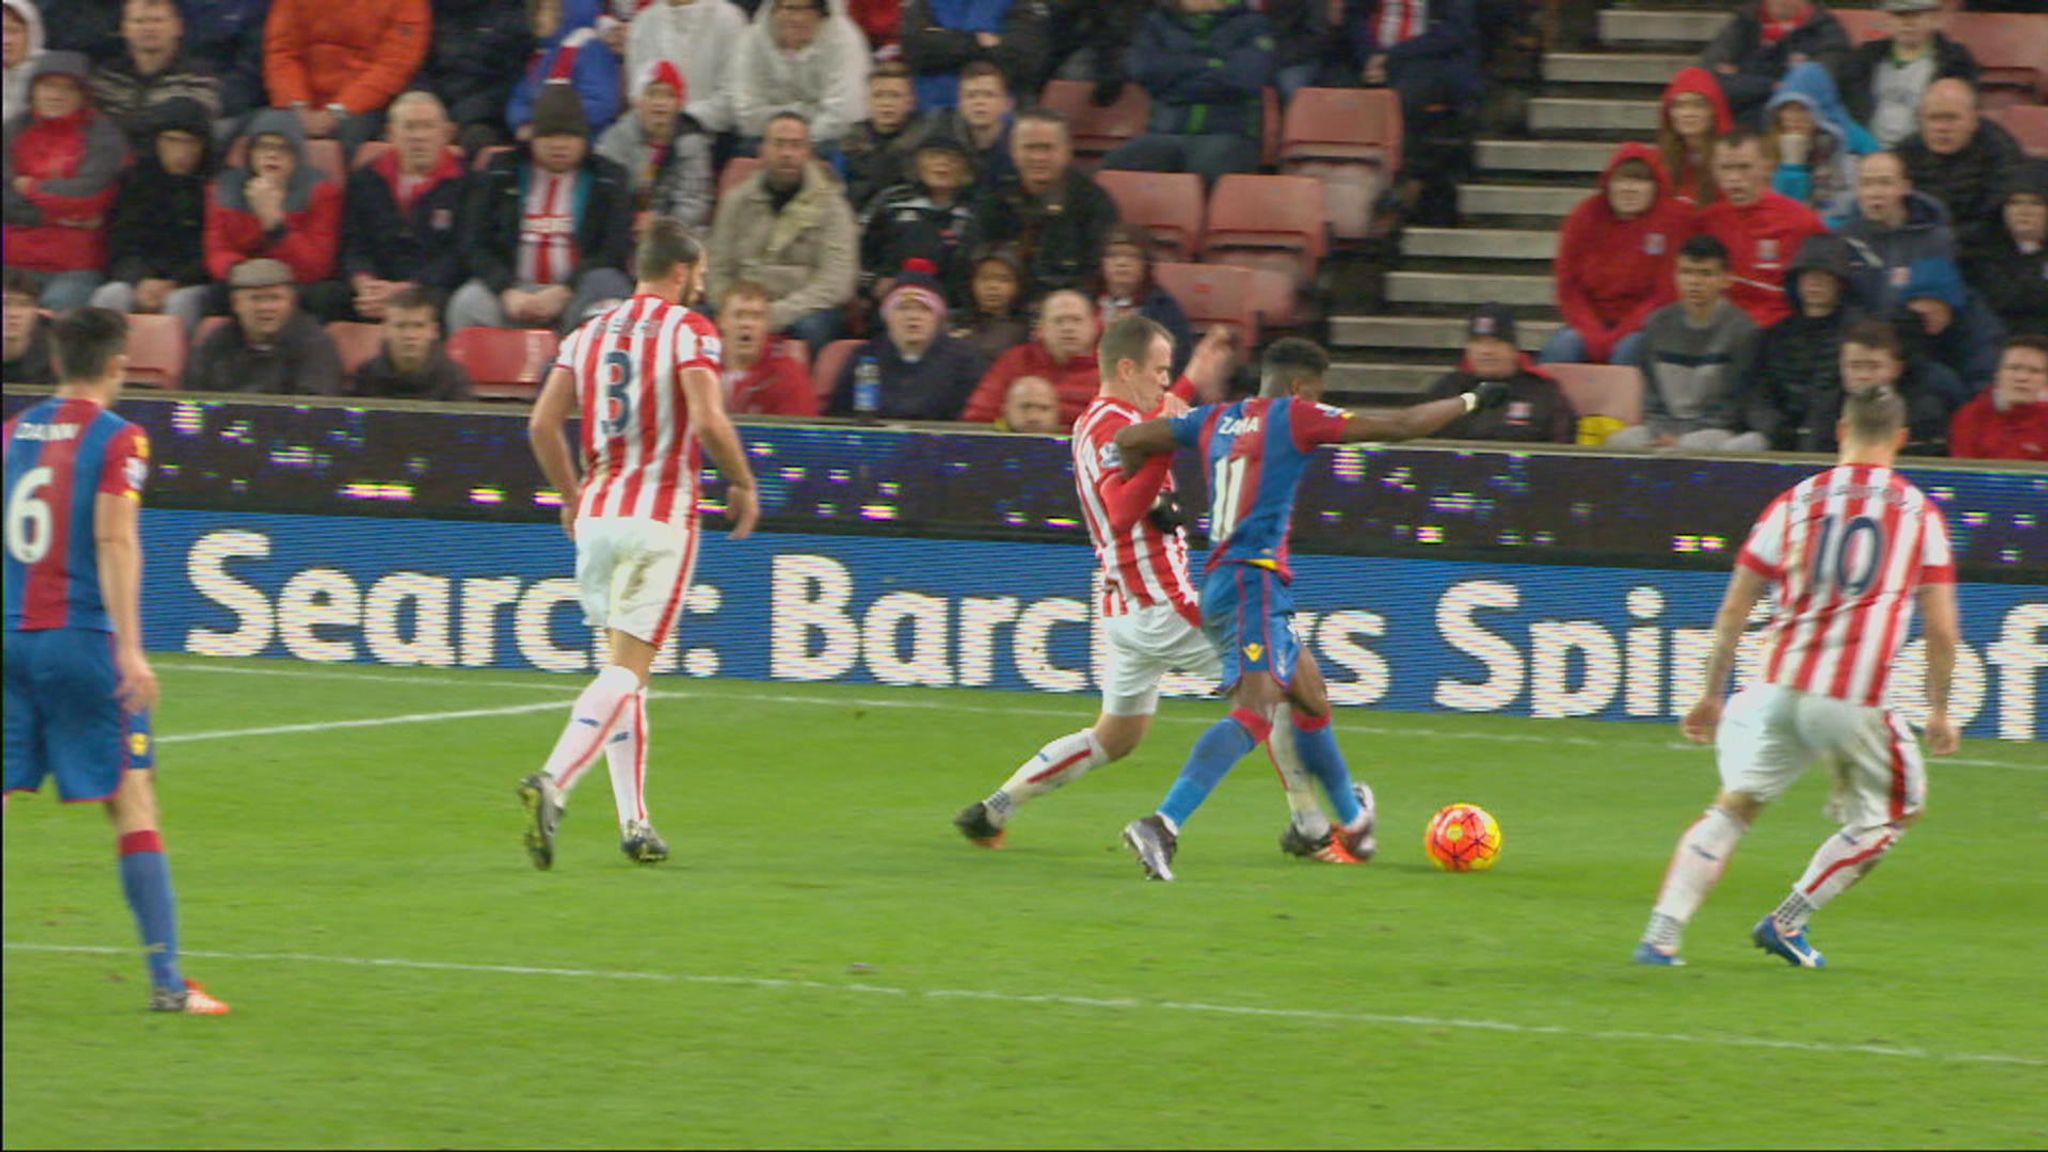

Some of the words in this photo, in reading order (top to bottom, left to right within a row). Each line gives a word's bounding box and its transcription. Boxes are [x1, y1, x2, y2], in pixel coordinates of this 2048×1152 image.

[601, 351, 632, 434] 3
[7, 466, 54, 564] 6
[1210, 456, 1246, 542] 11
[1815, 514, 1882, 596] 10
[186, 529, 722, 677] Searc:
[770, 555, 1391, 706] Barcs
